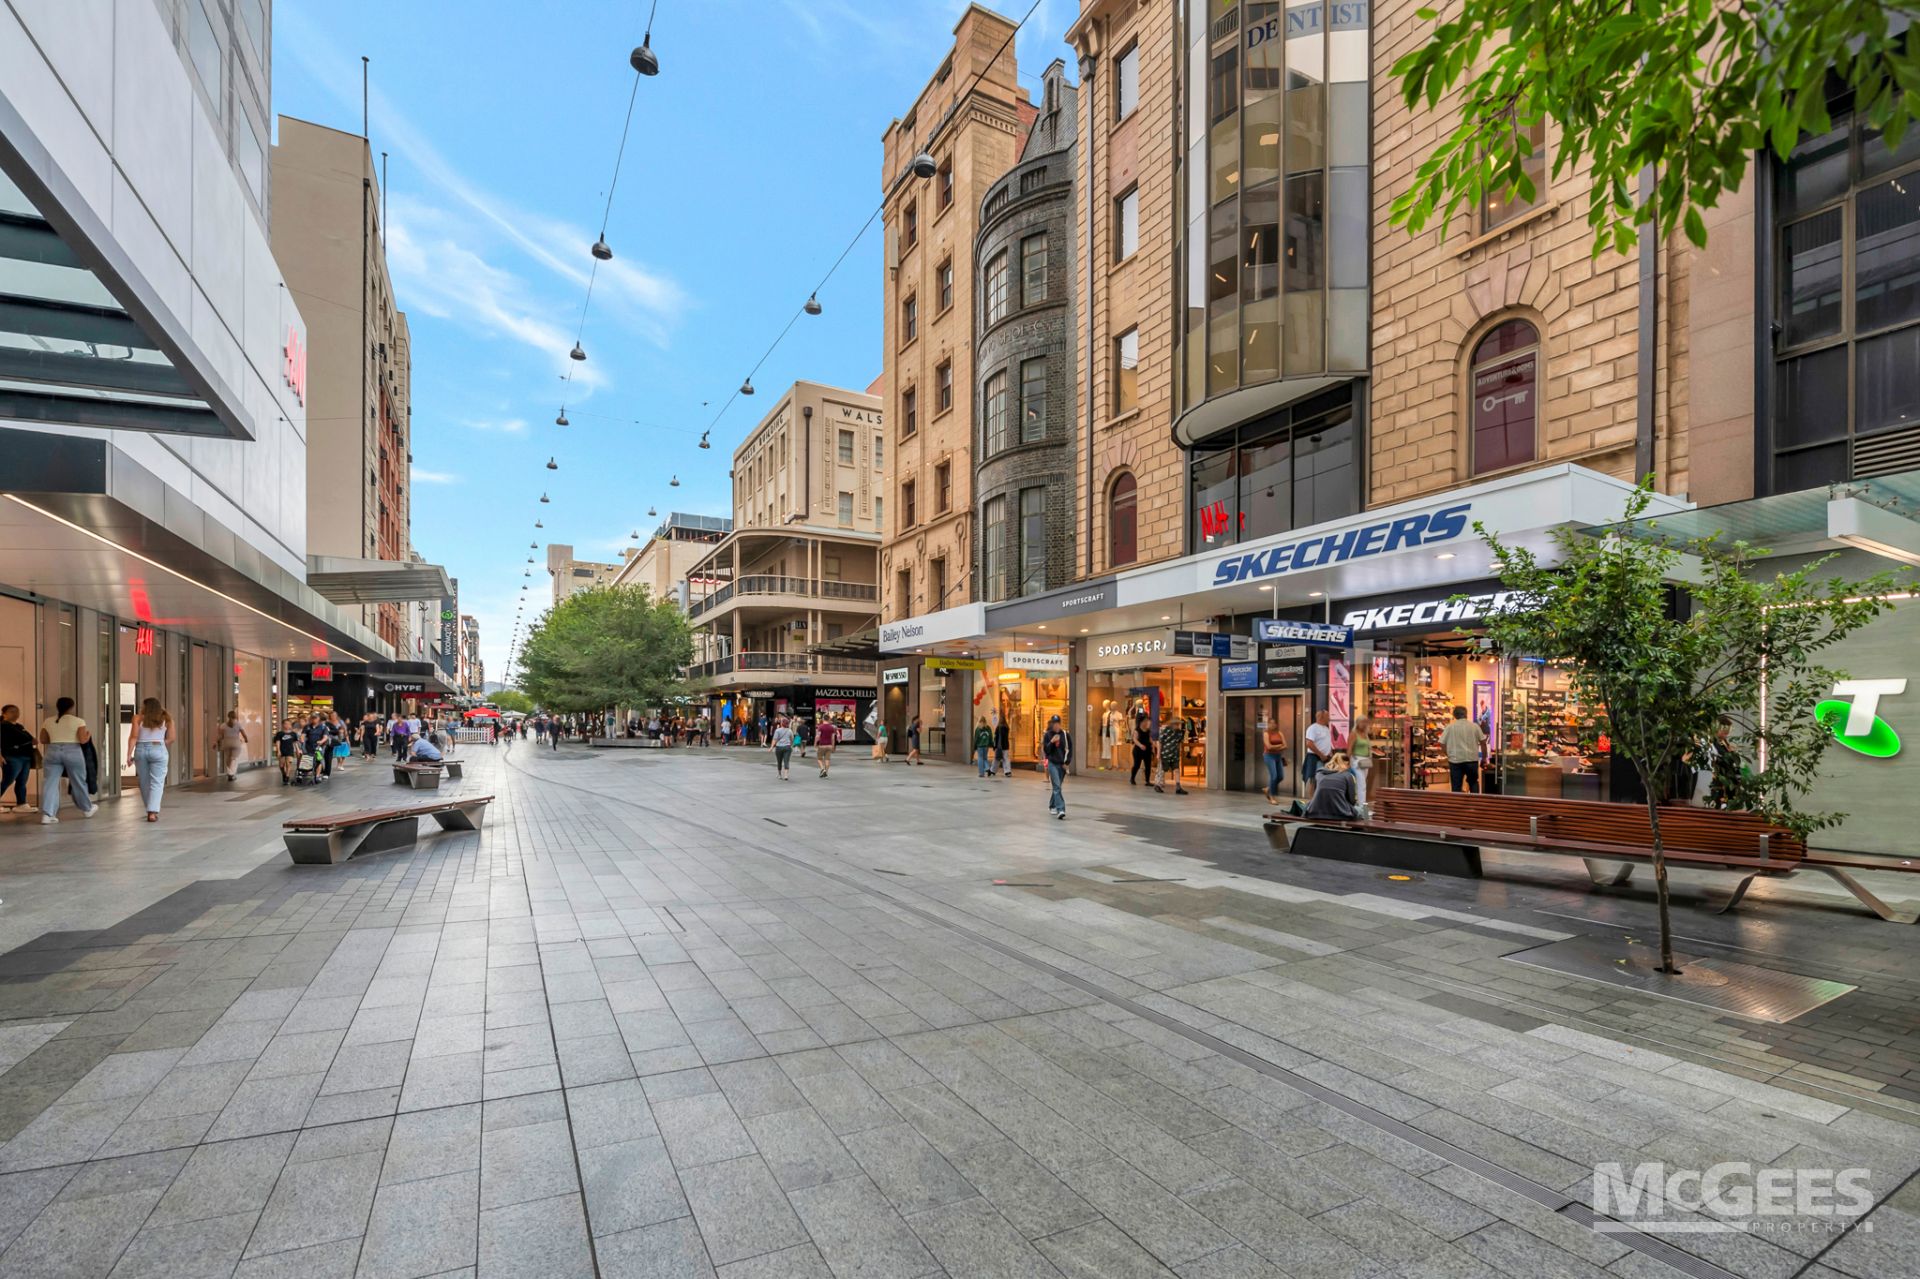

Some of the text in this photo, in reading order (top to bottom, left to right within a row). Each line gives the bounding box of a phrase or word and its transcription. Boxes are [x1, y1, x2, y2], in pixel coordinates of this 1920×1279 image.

[1248, 1, 1367, 49] DENTIST
[758, 413, 784, 447] BUILDING
[1213, 503, 1472, 586] SKECHERS
[1062, 592, 1105, 608] SPORTSCRAFT
[136, 625, 155, 656] H&M
[882, 623, 924, 644] Bailey Nelson
[1266, 625, 1348, 643] SKECHERS
[1012, 656, 1064, 666] SPORTSCRAFT
[394, 684, 422, 692] HYPE
[1832, 678, 1908, 737] T
